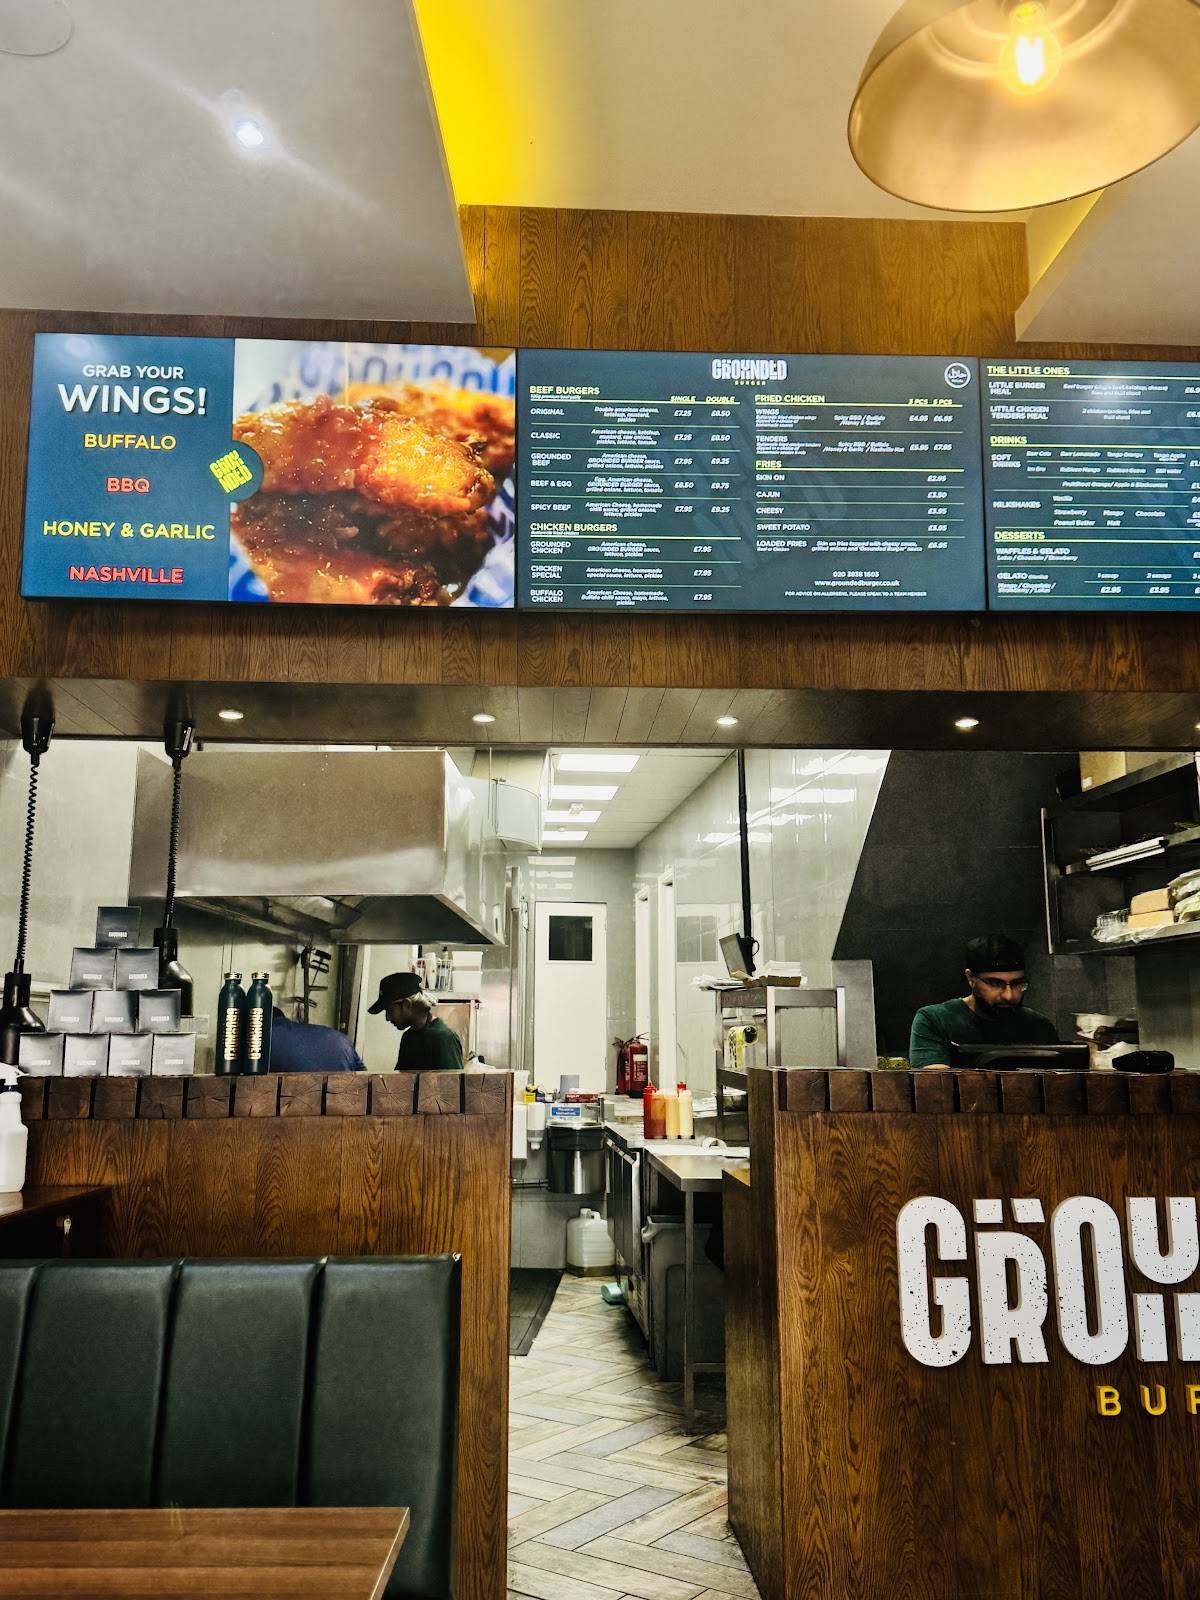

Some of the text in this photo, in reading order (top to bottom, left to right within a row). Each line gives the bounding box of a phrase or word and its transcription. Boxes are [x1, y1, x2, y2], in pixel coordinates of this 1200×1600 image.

[83, 364, 184, 379] GRAB YOUR
[712, 359, 787, 380] GROUNDED
[987, 366, 1070, 375] THE LITTLE ONES
[530, 386, 600, 395] BEEF BURGERS
[57, 383, 207, 415] WINGS!
[755, 395, 825, 403] FRIED CHICKEN
[84, 433, 176, 450] BUFFALO
[990, 436, 1027, 444] DRINKS
[107, 477, 150, 494] BBQ
[43, 521, 216, 541] HONEY & GARLIC
[530, 523, 617, 532] CHICKEN BURGERS
[995, 532, 1045, 540] DESSERTS
[69, 566, 184, 584] NASHVILLE
